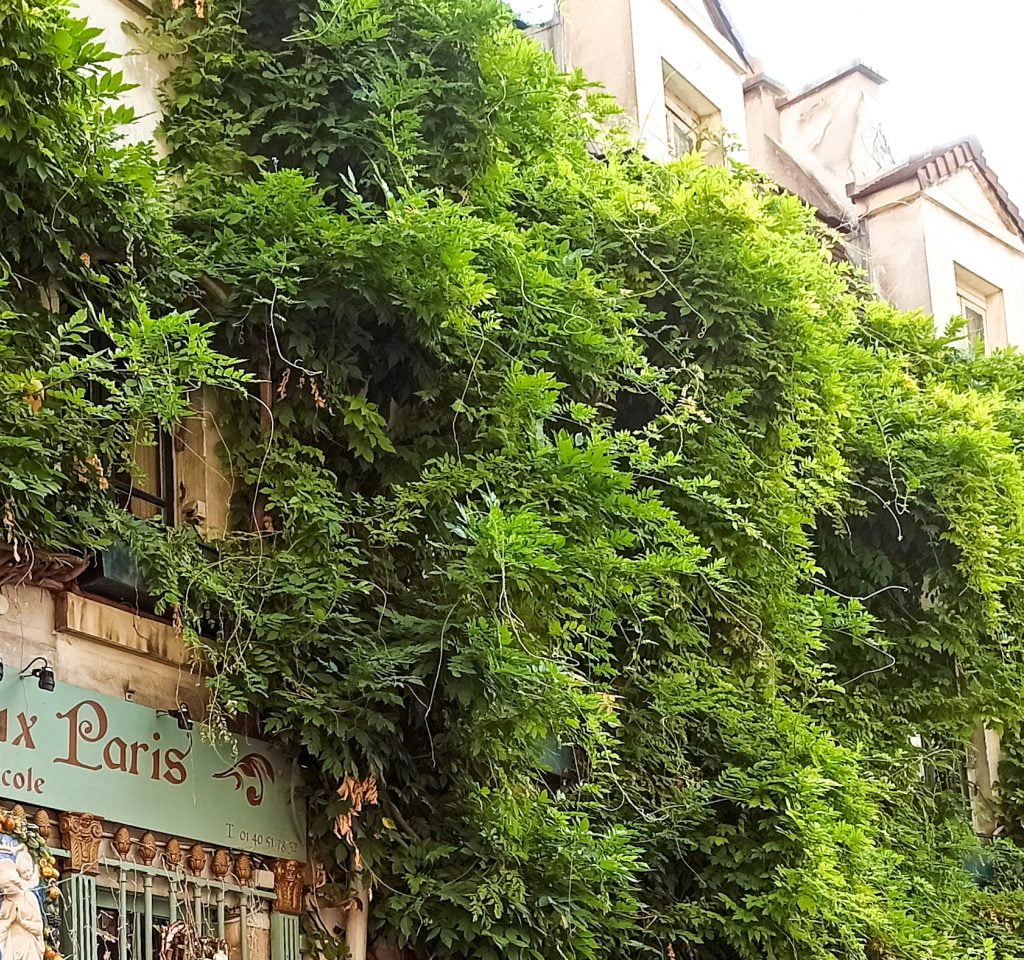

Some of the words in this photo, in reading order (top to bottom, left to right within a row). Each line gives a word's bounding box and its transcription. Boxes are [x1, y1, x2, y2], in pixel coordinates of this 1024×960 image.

[53, 699, 190, 785] Paris
[239, 831, 249, 842] 01
[251, 833, 264, 849] 40
